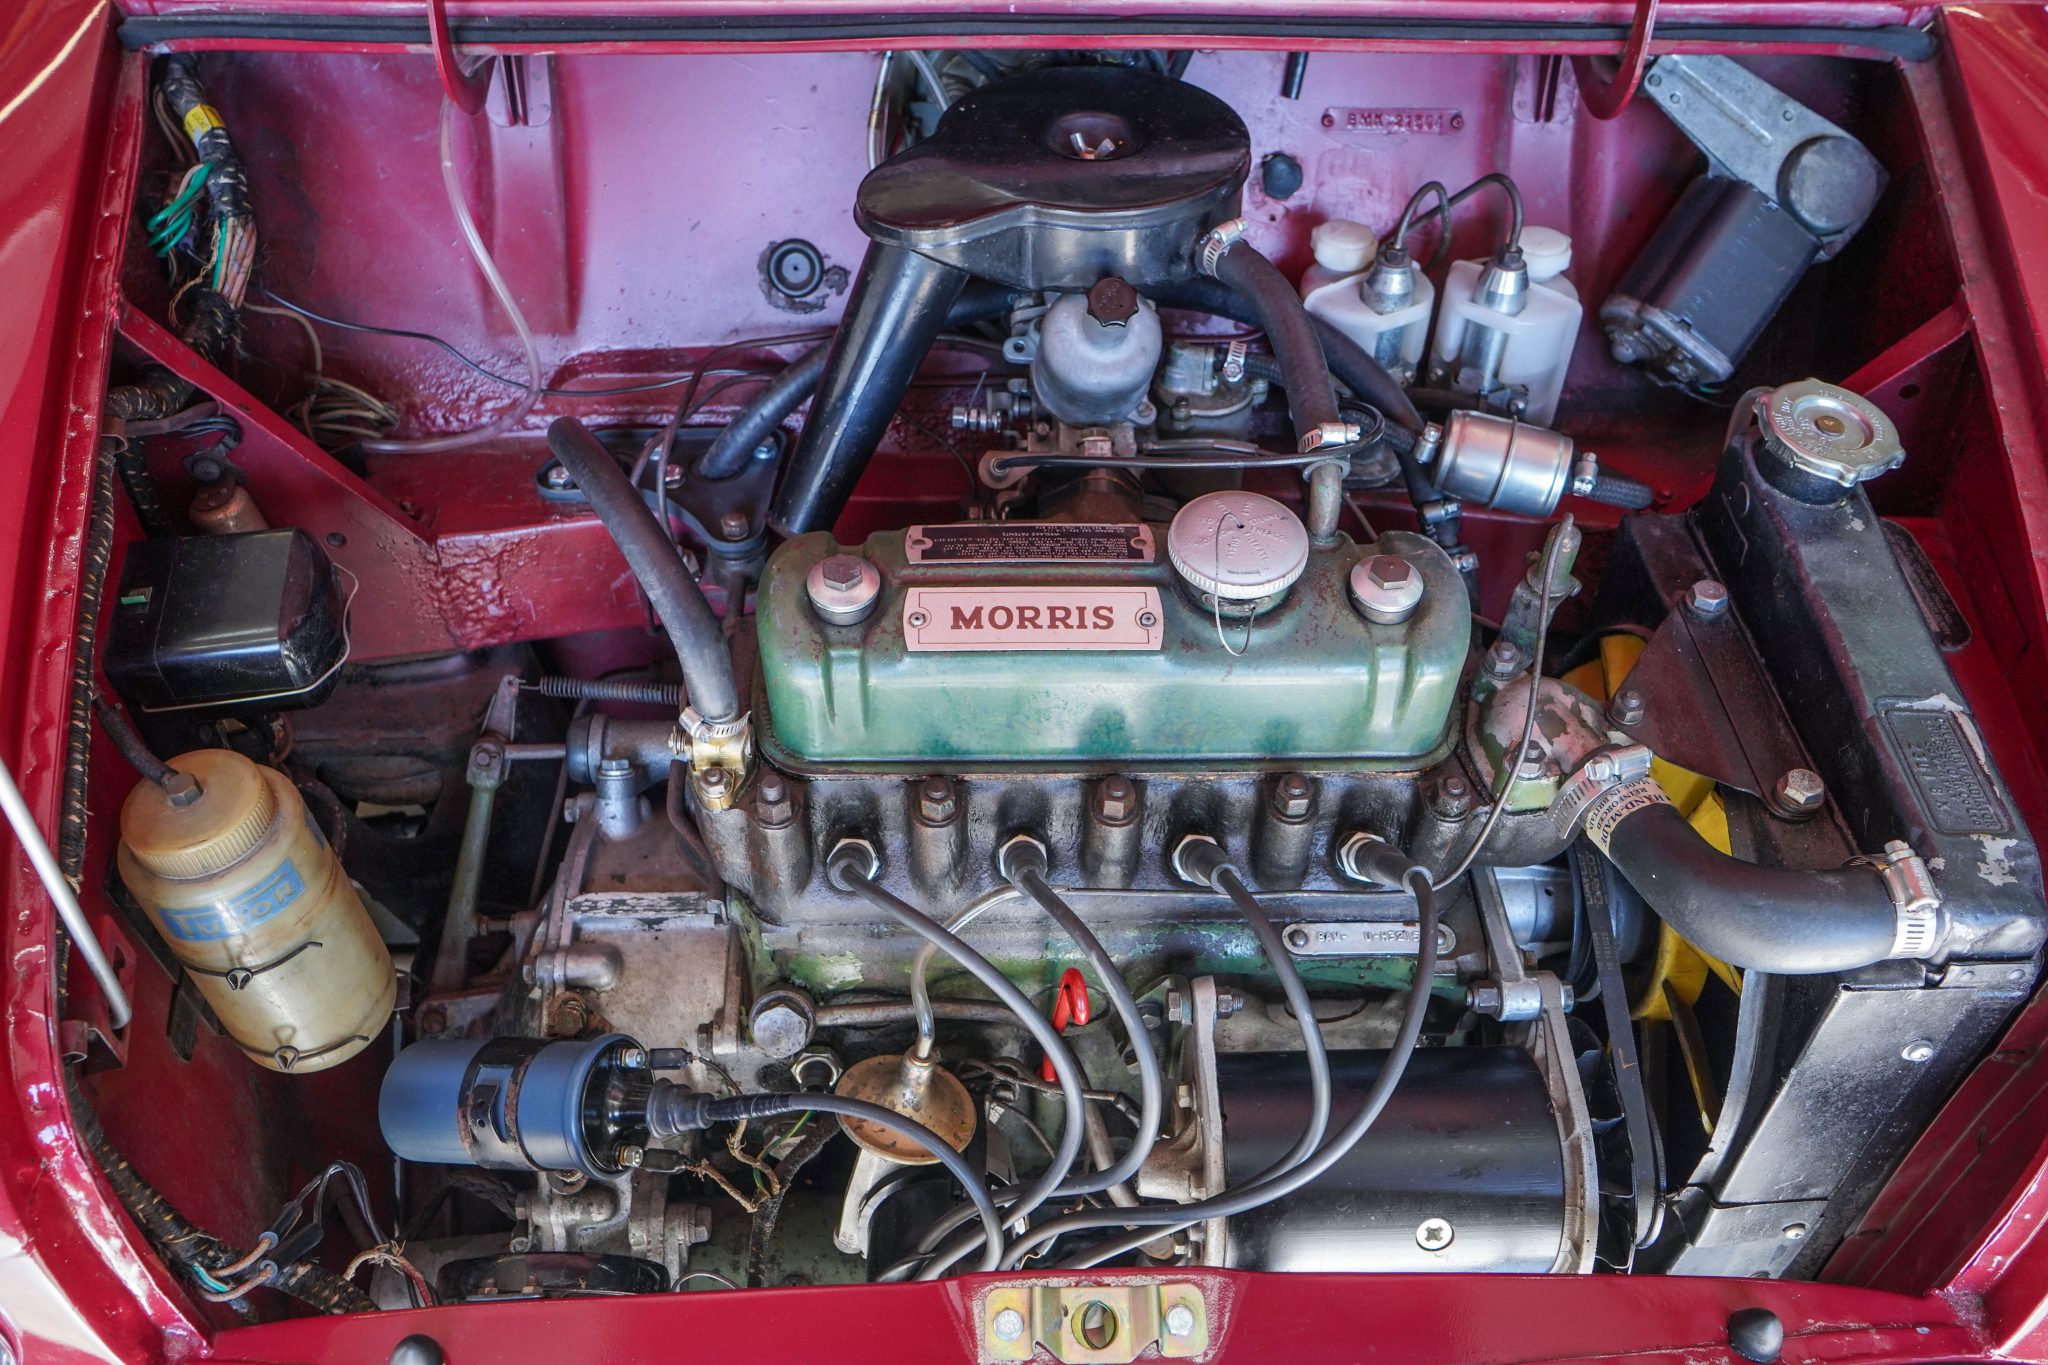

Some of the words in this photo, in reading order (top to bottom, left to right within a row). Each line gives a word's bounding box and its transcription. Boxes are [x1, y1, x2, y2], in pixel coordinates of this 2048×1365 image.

[950, 605, 1115, 630] MORRIS
[1610, 788, 1620, 798] IN
[1624, 779, 1651, 790] MADE
[1589, 797, 1610, 832] BRITAIN
[1597, 787, 1648, 830] REINFORCED
[1601, 794, 1665, 847] HAND-MADE
